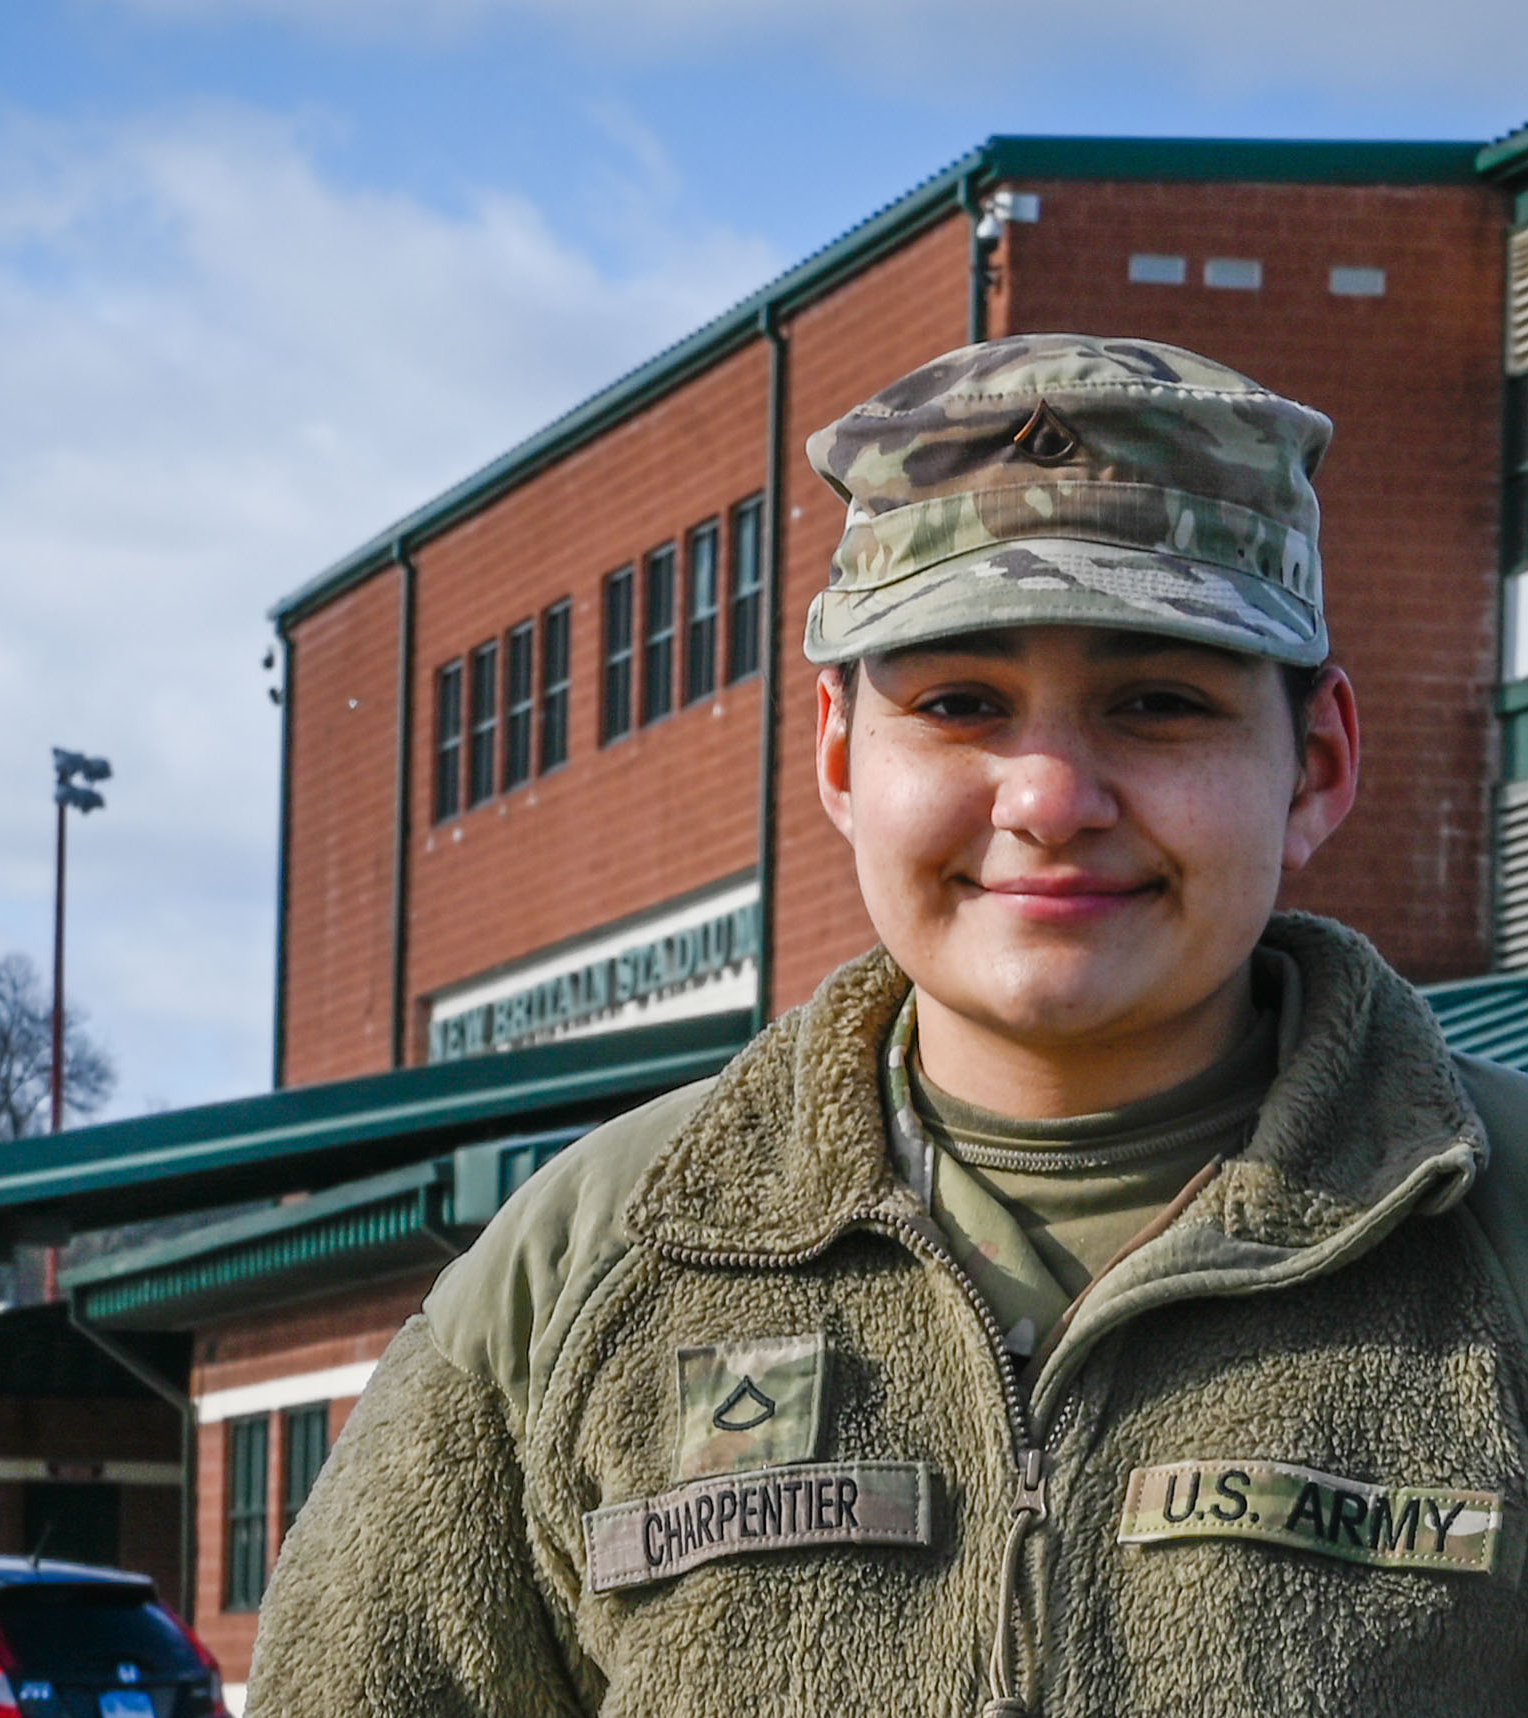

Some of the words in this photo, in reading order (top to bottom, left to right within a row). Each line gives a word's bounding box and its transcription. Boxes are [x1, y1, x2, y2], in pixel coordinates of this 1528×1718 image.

[429, 1010, 488, 1064] NEW
[493, 959, 611, 1044] BRITAIN
[616, 902, 762, 1003] STADIUM
[642, 1477, 859, 1567] CHARPENTIER
[1163, 1469, 1261, 1525] U.S.
[1285, 1481, 1466, 1552] ARMY
